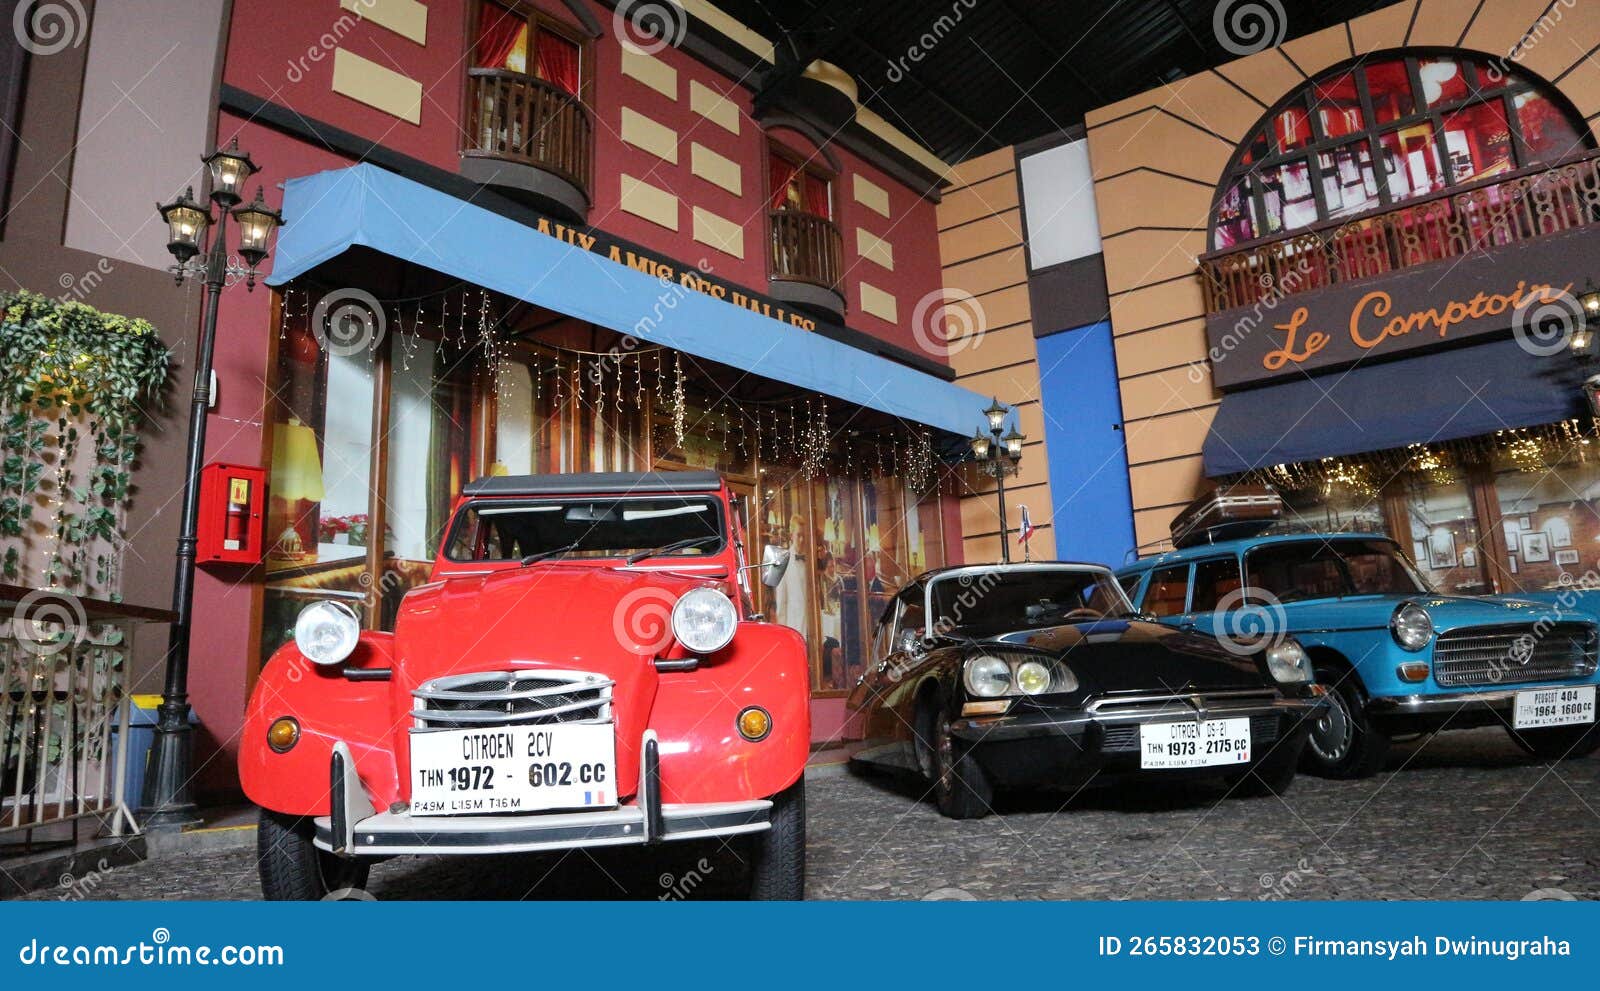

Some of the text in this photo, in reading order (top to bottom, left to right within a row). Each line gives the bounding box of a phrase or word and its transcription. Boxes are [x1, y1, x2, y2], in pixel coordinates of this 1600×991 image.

[1263, 280, 1573, 370] Le Comptoir
[1534, 690, 1578, 704] PEUGEOT 404
[1520, 705, 1534, 715] THN
[1535, 705, 1556, 717] 1964
[1561, 703, 1582, 715] 1600
[1170, 724, 1201, 739] CITROEN
[462, 732, 553, 760] CITROEN 2CV
[1147, 743, 1163, 754] THN
[1167, 742, 1196, 756] 1973
[1206, 739, 1232, 754] 2175
[419, 769, 444, 787] THN
[448, 765, 494, 791] 1972
